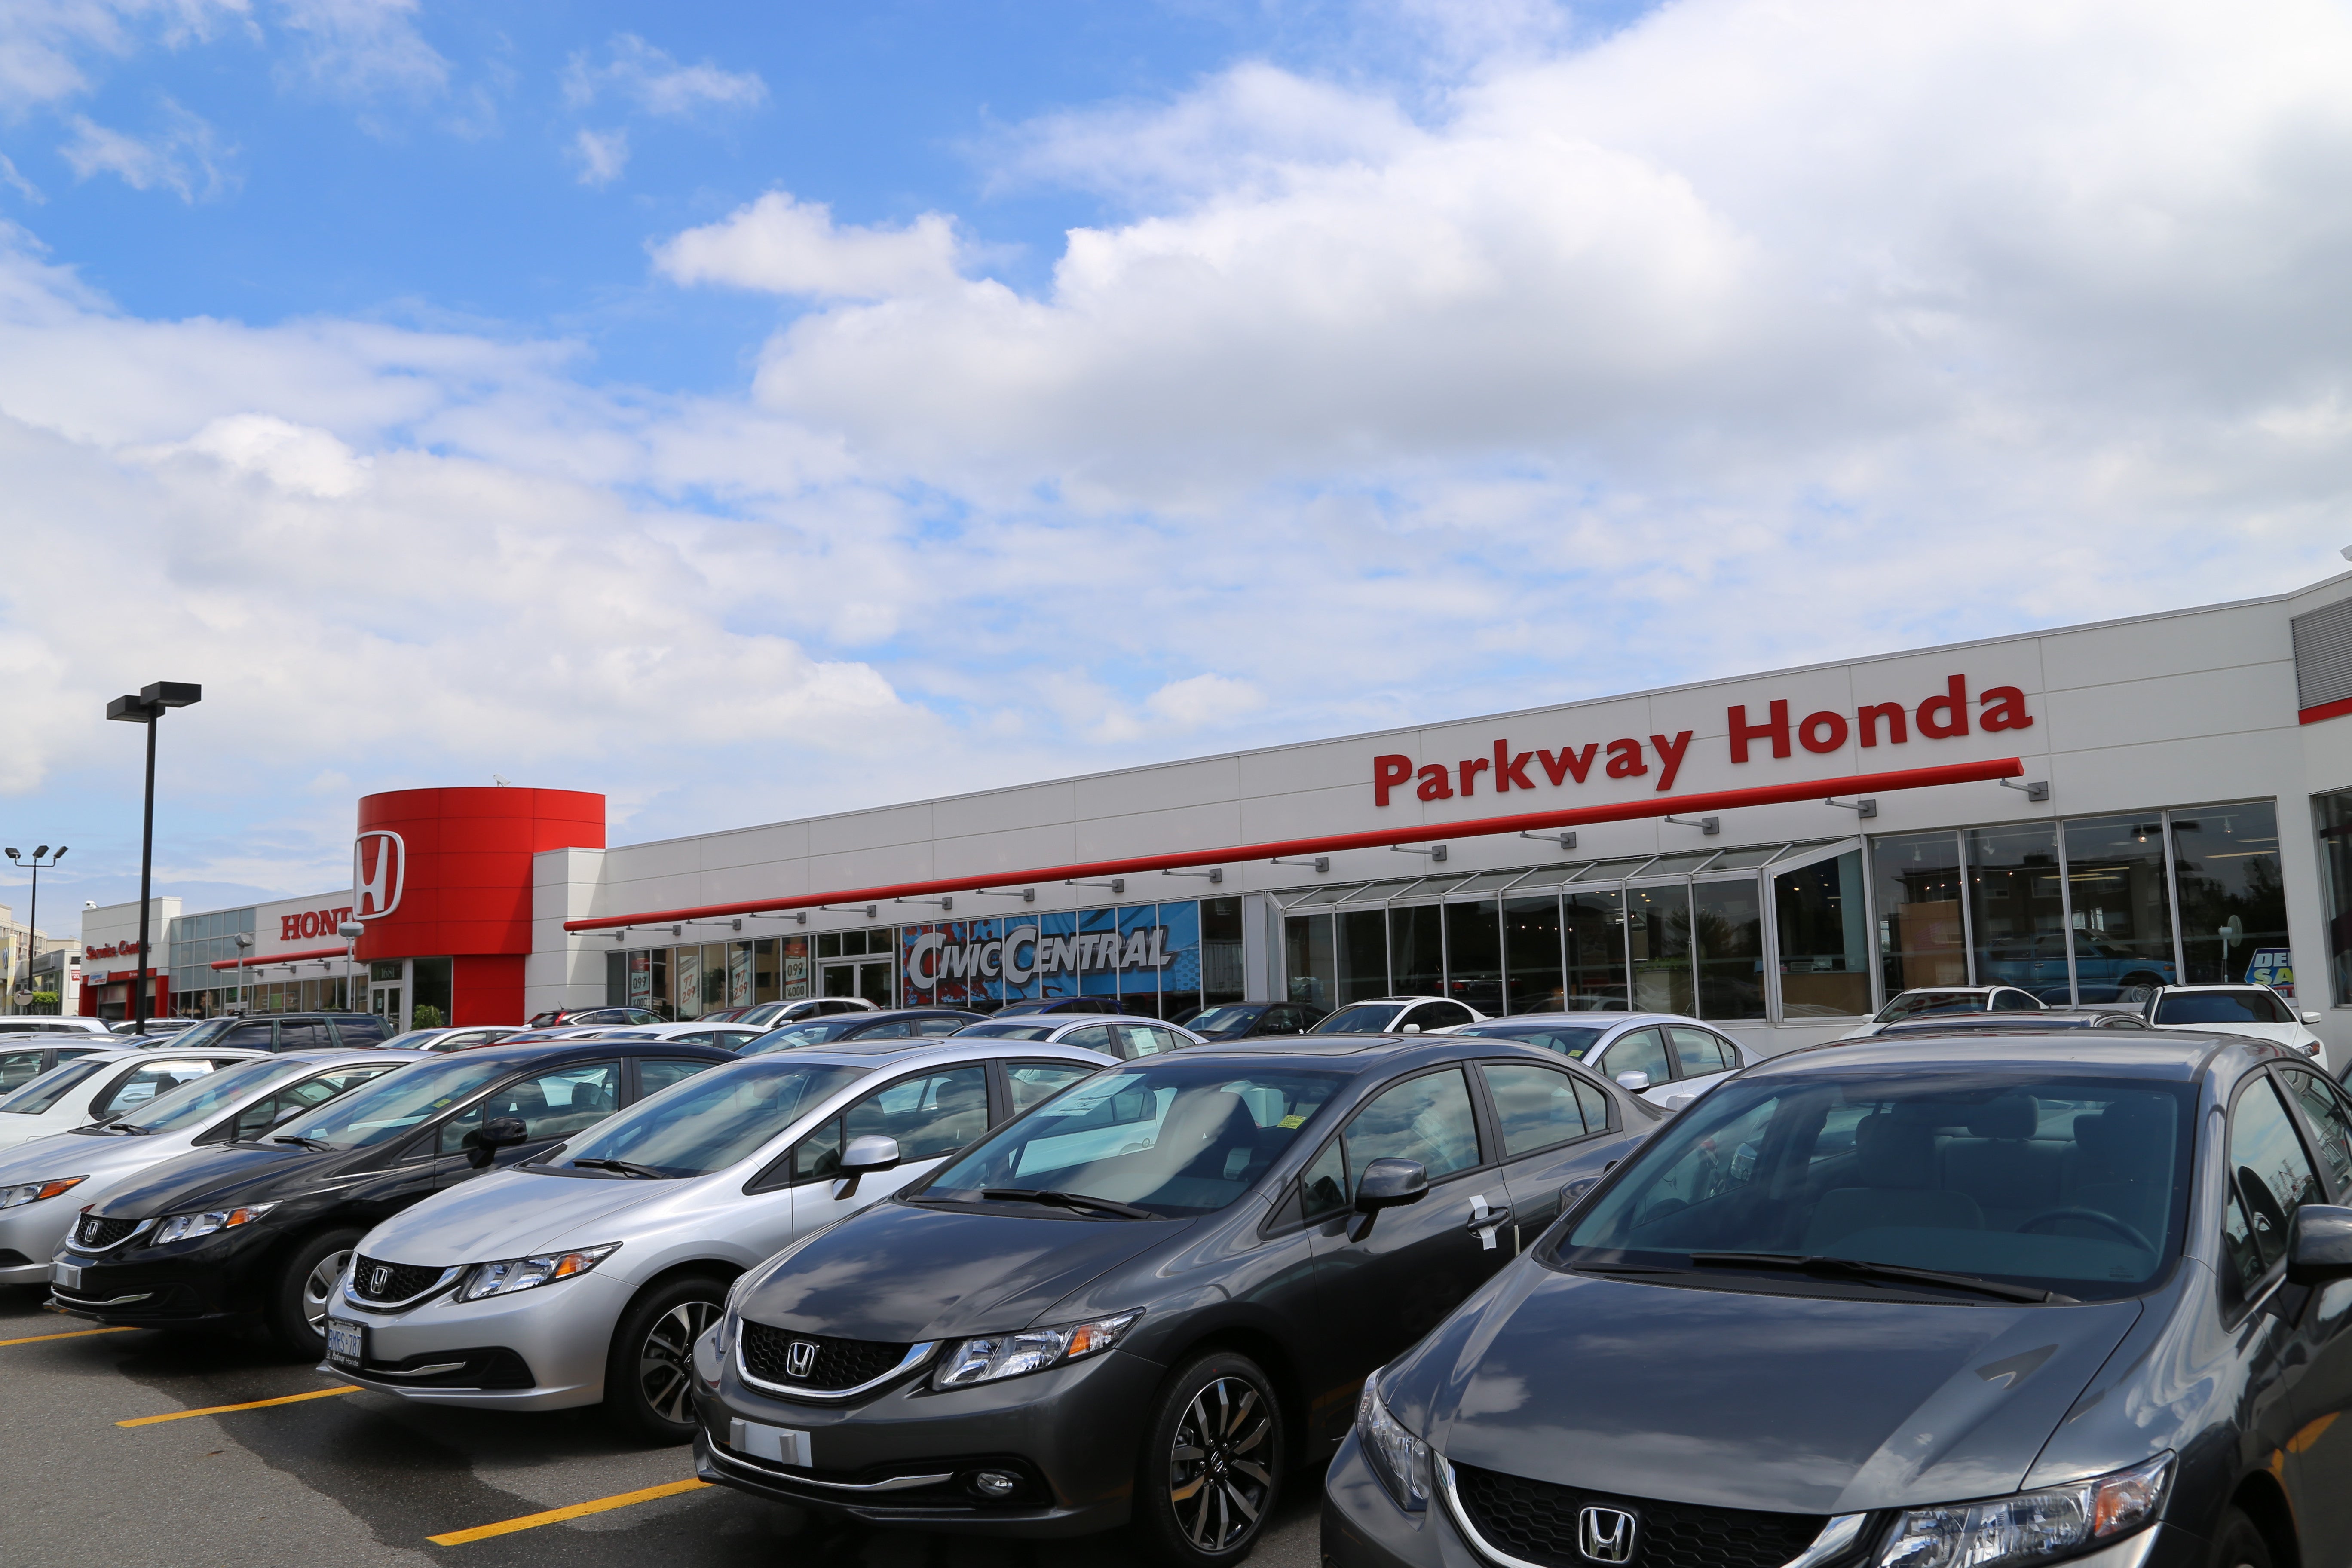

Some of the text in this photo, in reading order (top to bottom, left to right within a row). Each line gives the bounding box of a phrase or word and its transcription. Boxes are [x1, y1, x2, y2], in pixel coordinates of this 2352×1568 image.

[1374, 674, 2033, 806] Parkway Honda
[86, 943, 116, 960] Service
[2254, 952, 2292, 967] DE
[381, 966, 395, 978] 1681
[328, 1329, 345, 1352] BMRS
[346, 1357, 358, 1366] Honda
